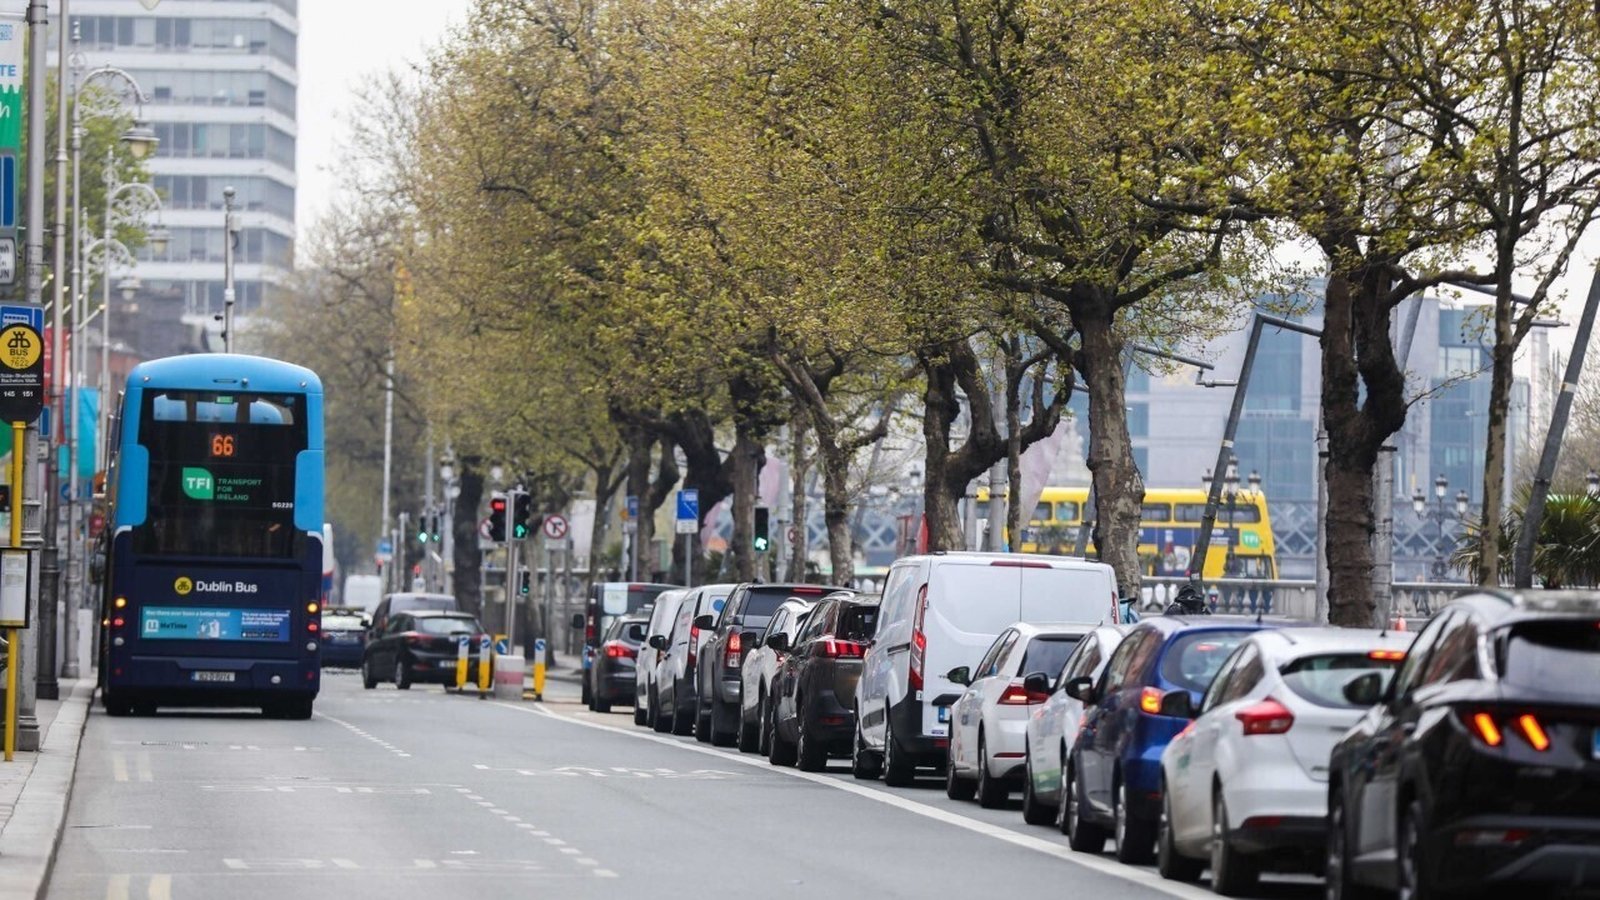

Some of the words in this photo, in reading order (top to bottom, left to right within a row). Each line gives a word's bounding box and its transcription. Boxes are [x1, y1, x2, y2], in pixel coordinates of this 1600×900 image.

[212, 434, 234, 456] 66
[186, 477, 211, 490] TFI
[217, 478, 262, 486] TRANSPORT
[216, 493, 250, 501] IRELAND
[195, 580, 233, 593] Dublin
[235, 581, 259, 593] Bus
